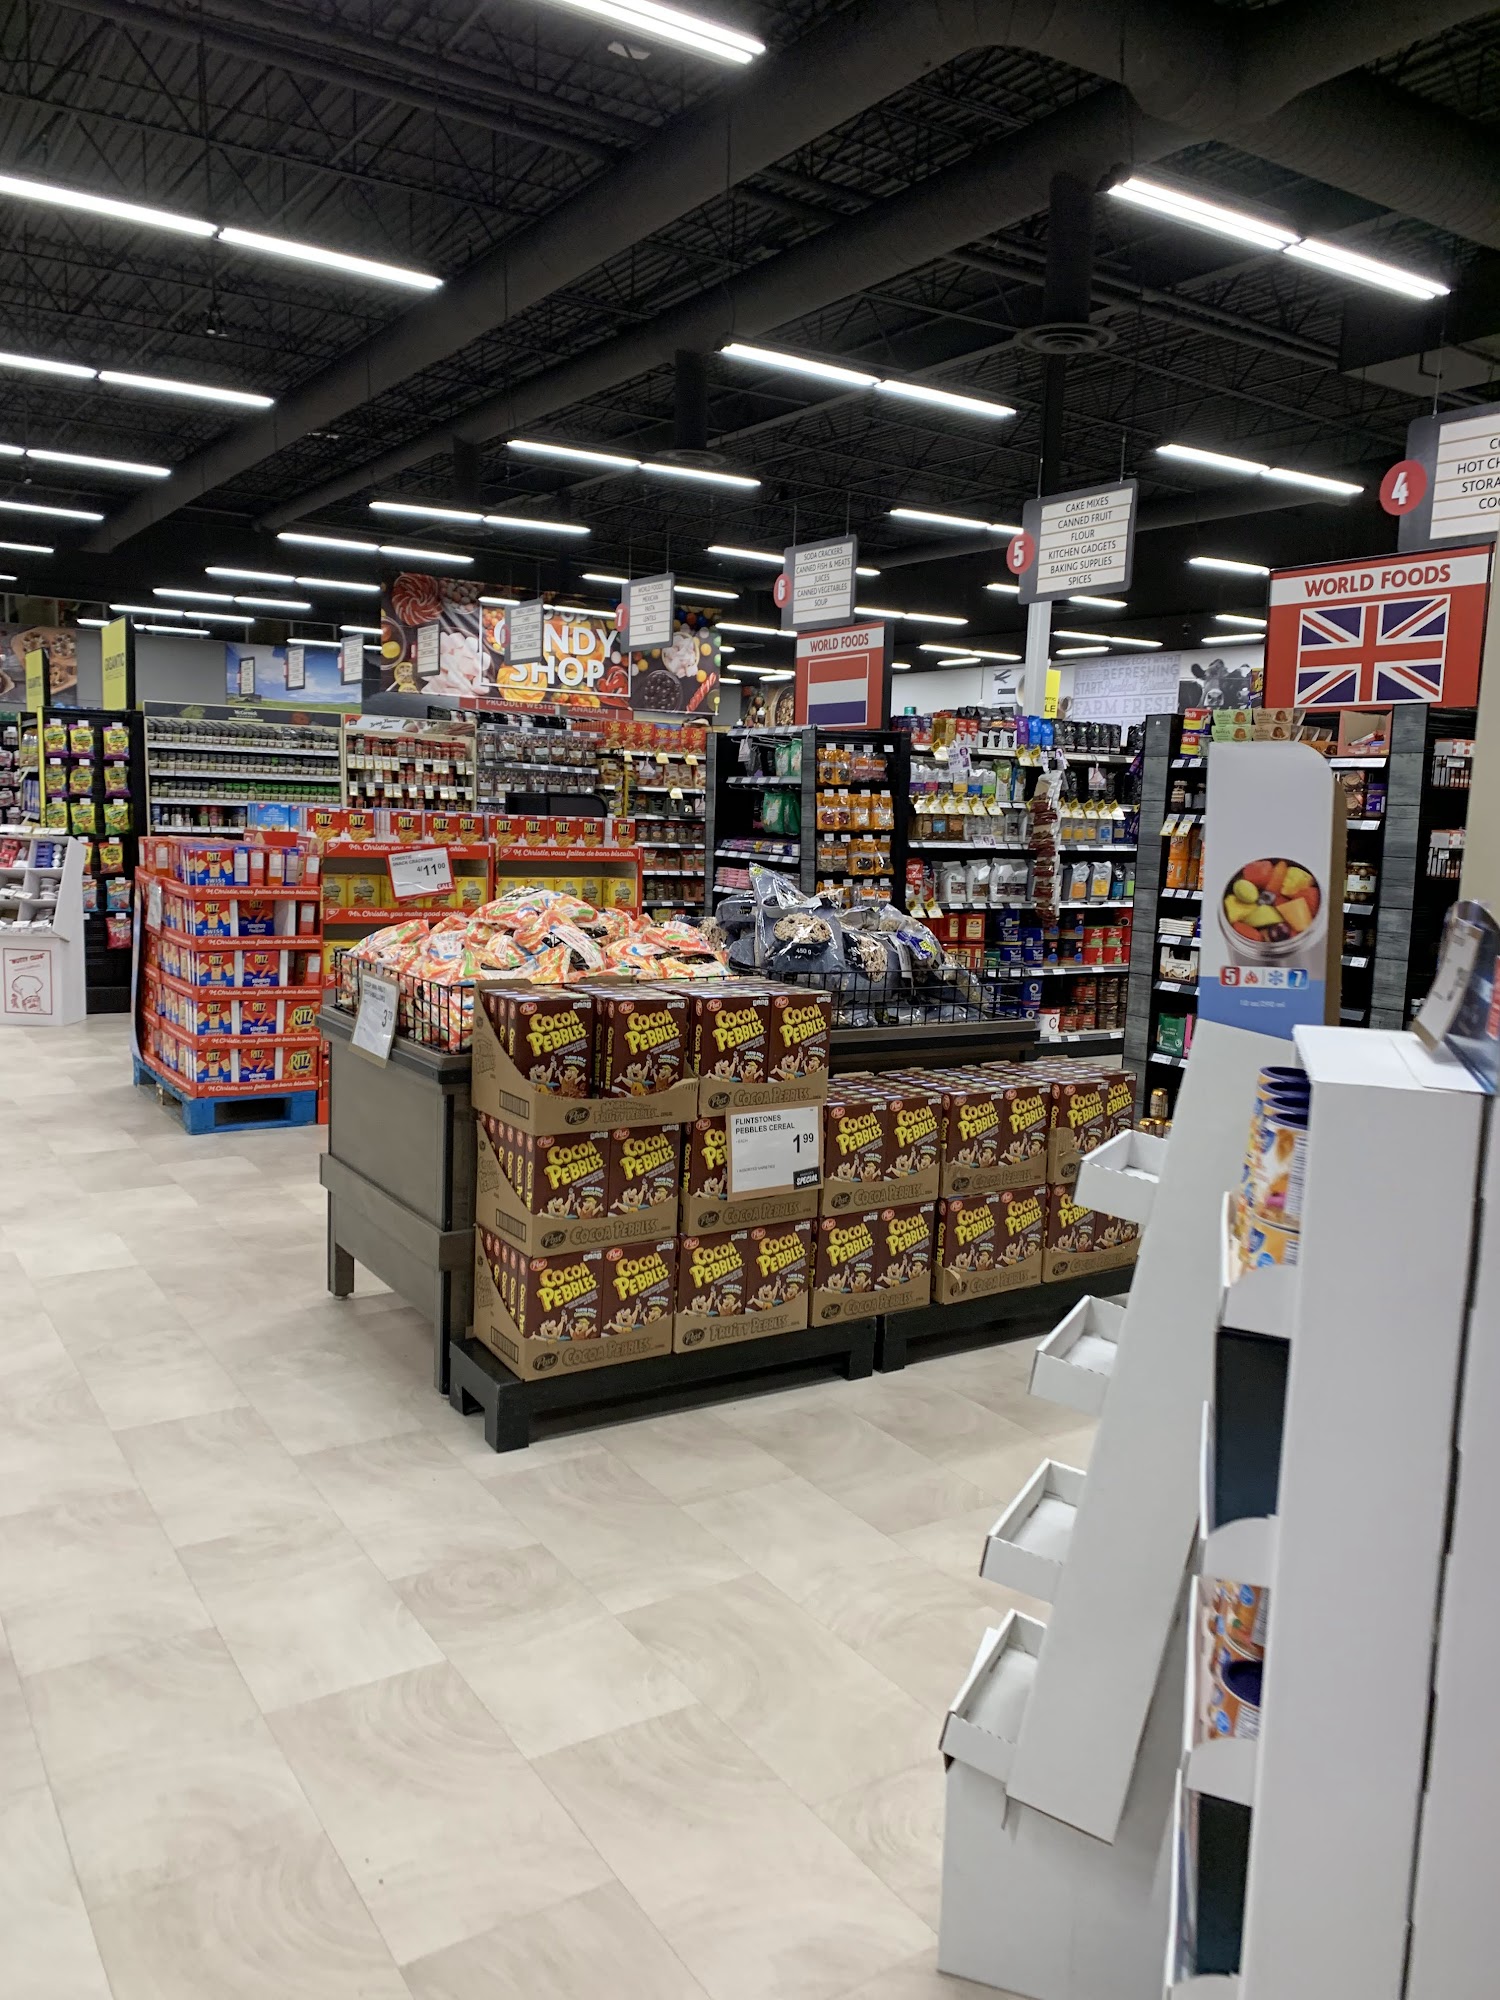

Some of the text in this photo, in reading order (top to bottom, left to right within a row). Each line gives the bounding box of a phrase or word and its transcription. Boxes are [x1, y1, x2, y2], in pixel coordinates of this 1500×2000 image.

[1490, 438, 1500, 449] C
[1457, 460, 1484, 474] HOT
[1391, 471, 1409, 505] 4
[1066, 496, 1109, 513] CAKE MIXES
[1479, 497, 1500, 510] CO
[1058, 510, 1112, 529] CANNED FRUIT
[1071, 529, 1094, 541] FLOUR
[804, 547, 843, 561] SODA CRACKERS
[1013, 541, 1025, 568] 5
[1048, 540, 1116, 560] KITCHEN GADGETS
[796, 557, 850, 574] CANNED FISH & MEATS
[1050, 556, 1112, 574] BAKING SUPPLIES
[814, 574, 830, 584] JUICES
[1068, 574, 1092, 586] SPICES
[1305, 564, 1451, 598] WORLD FOODS
[777, 579, 786, 601] 6
[797, 583, 847, 598] CANNED VEGETABLES
[814, 598, 828, 607] SOUP
[494, 623, 618, 658] CNDY
[810, 632, 869, 653] WORLD FOODS
[509, 655, 605, 688] SHOP
[1104, 664, 1180, 680] REFRESHING
[1074, 697, 1177, 715] FARM FRESH
[315, 812, 332, 824] RITZ
[349, 813, 366, 826] RITZ
[398, 815, 414, 828] RITZ
[433, 818, 449, 830] RITZ
[460, 818, 476, 830] RITZ
[496, 820, 512, 831] RITZ
[525, 820, 541, 831] RITZ
[555, 821, 570, 832] RITZ
[584, 822, 597, 833] RITZ
[618, 823, 631, 834] RITZ
[207, 852, 221, 862] RITZ
[409, 857, 433, 866] CRACKERS
[523, 849, 550, 858] Christie,
[566, 849, 586, 858] faites
[204, 903, 220, 913] RITZ
[1224, 968, 1302, 987] 5 7
[252, 1002, 266, 1012] RITZ
[292, 1008, 314, 1024] RITZ
[782, 1004, 821, 1025] COCOA
[529, 1010, 580, 1033] COCOA
[627, 1009, 674, 1031] COCOA
[715, 1007, 758, 1029] COCOA
[526, 1023, 588, 1057] PEBBLES
[624, 1022, 681, 1055] PEBBLES
[712, 1020, 765, 1052] PEBBLES
[780, 1016, 827, 1048] PEBBLES
[290, 1053, 312, 1070] RITZ
[733, 1089, 770, 1107] COCOA
[772, 1087, 810, 1103] PEBBLES
[1070, 1091, 1101, 1110] COCOA
[735, 1115, 781, 1125] FLINTSTONES
[838, 1113, 878, 1134] COCOA
[897, 1106, 933, 1127] COCOA
[1067, 1101, 1104, 1129] PEBBLES
[736, 1123, 795, 1134] PEBBLES CEREAL
[894, 1117, 938, 1148] PEBBLES
[622, 1133, 669, 1157] COCOA
[836, 1124, 883, 1156] PEBBLES
[547, 1141, 597, 1165] COCOA
[619, 1145, 676, 1181] PEBBLES
[544, 1152, 605, 1190] PEBBLES
[796, 1174, 818, 1185] SPECIAL
[723, 1205, 760, 1225] COCOA
[761, 1201, 800, 1219] PEBBLES
[569, 1226, 613, 1246] COCOA
[613, 1219, 658, 1239] PEBBLES
[829, 1223, 868, 1245] COCOA
[888, 1213, 925, 1235] COCOA
[759, 1232, 801, 1255] COCOA
[826, 1234, 874, 1267] PEBBLES
[886, 1224, 931, 1257] PEBBLES
[691, 1242, 737, 1266] COCOA
[756, 1243, 807, 1278] PEBBLES
[615, 1252, 663, 1277] COCOA
[689, 1253, 744, 1288] PEBBLES
[539, 1263, 590, 1287] COCOA
[613, 1264, 670, 1301] PEBBLES
[536, 1275, 599, 1312] PEBBLES
[709, 1322, 750, 1342] FRUITY
[751, 1314, 790, 1333] PEBBLES
